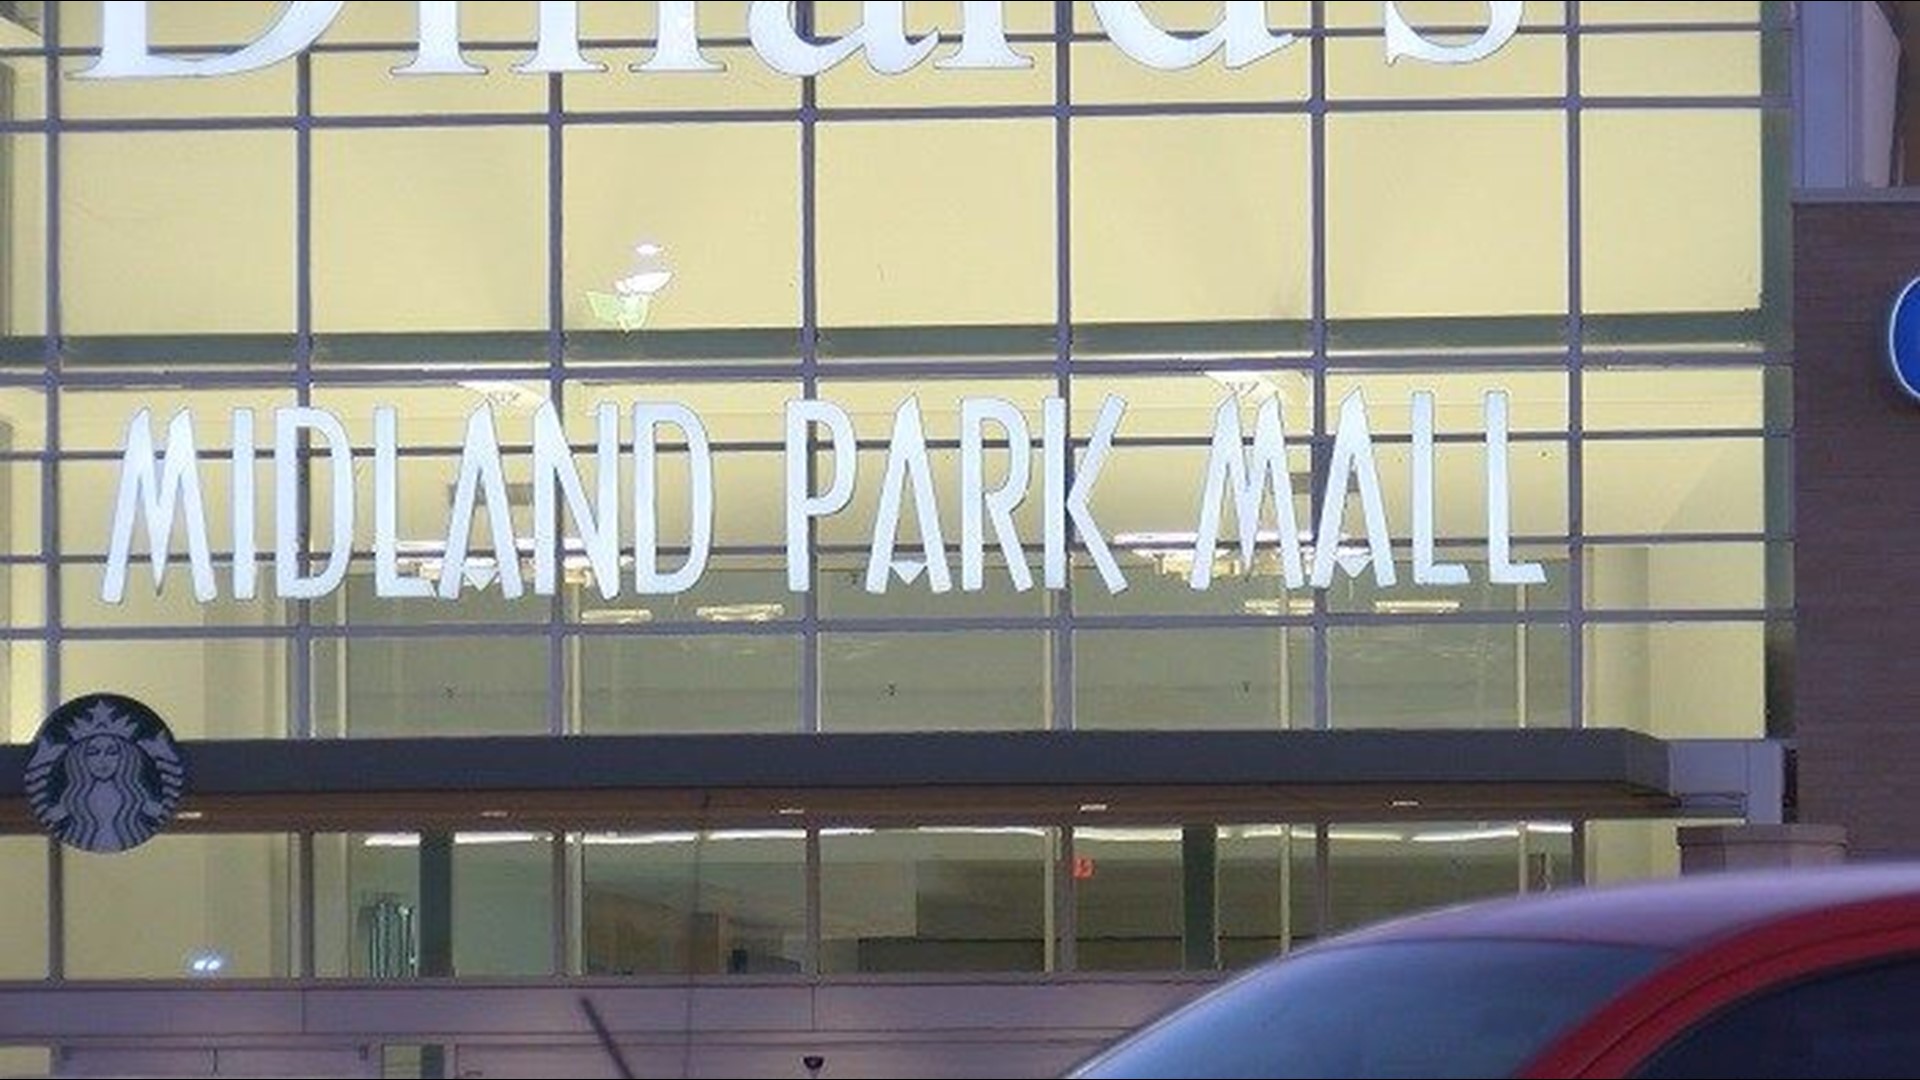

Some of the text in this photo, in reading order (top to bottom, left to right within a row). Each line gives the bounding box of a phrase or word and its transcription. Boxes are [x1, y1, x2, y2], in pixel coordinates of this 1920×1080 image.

[101, 388, 1548, 602] MIDLAND PARK MALL
